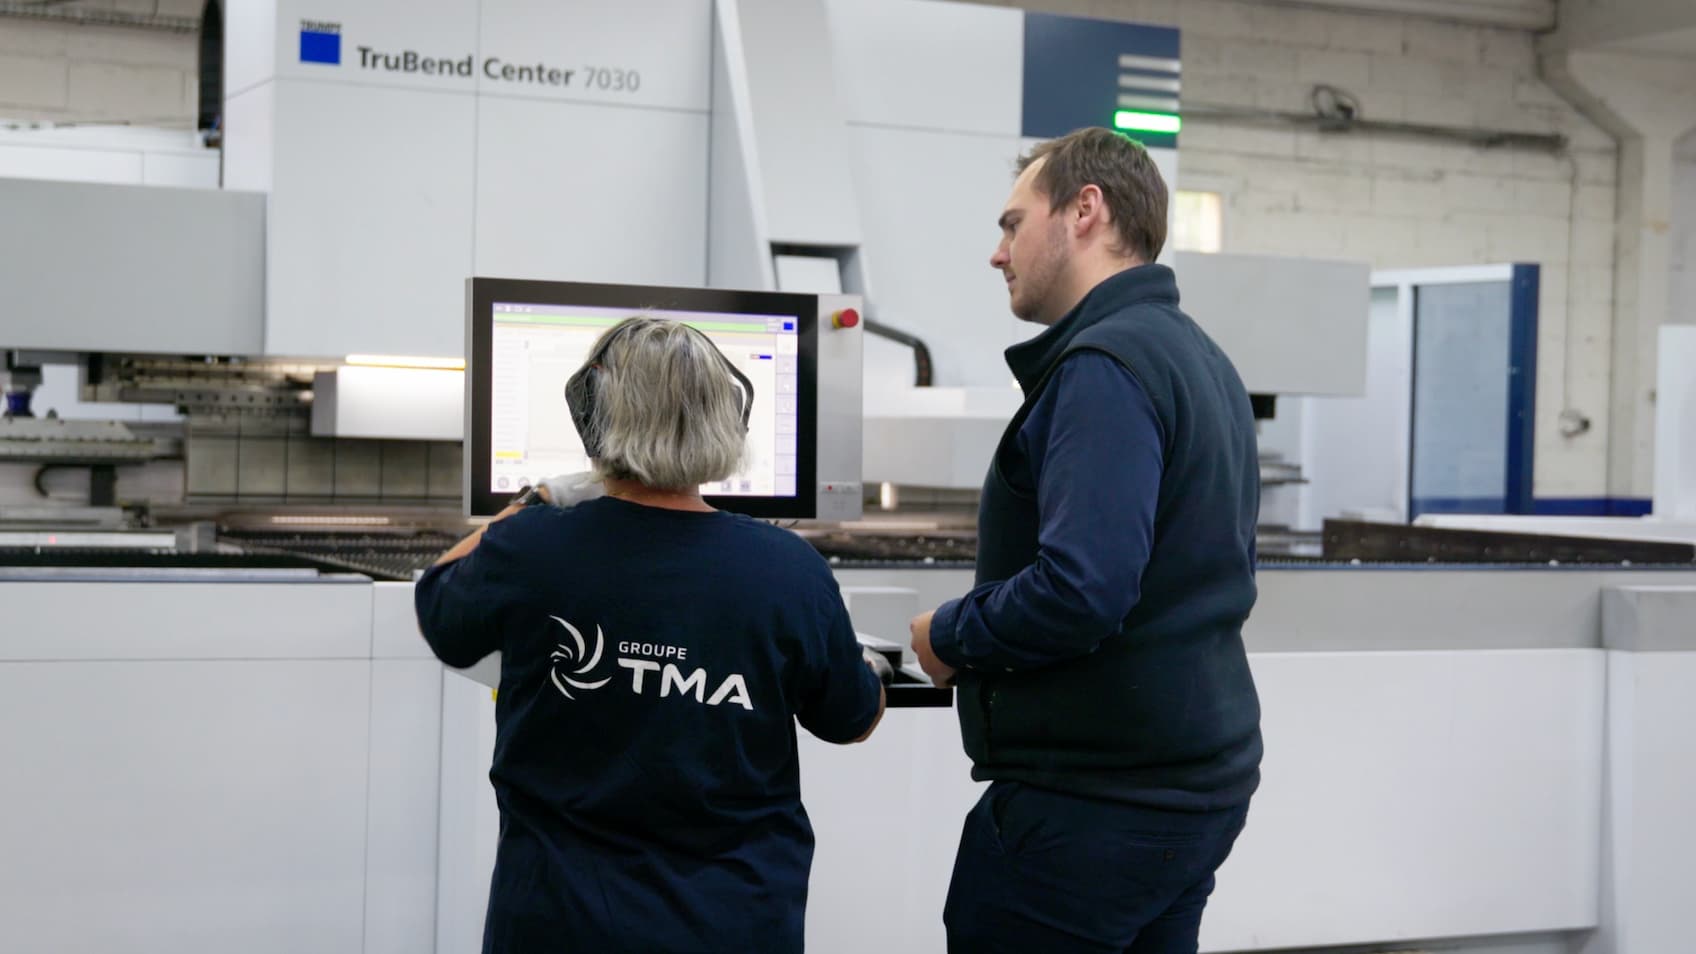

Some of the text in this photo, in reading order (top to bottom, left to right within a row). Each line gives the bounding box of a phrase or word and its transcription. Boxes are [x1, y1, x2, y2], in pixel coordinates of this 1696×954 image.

[357, 45, 641, 92] TruBend Center 7030
[618, 641, 687, 660] GROUPE
[617, 657, 754, 711] TMA
